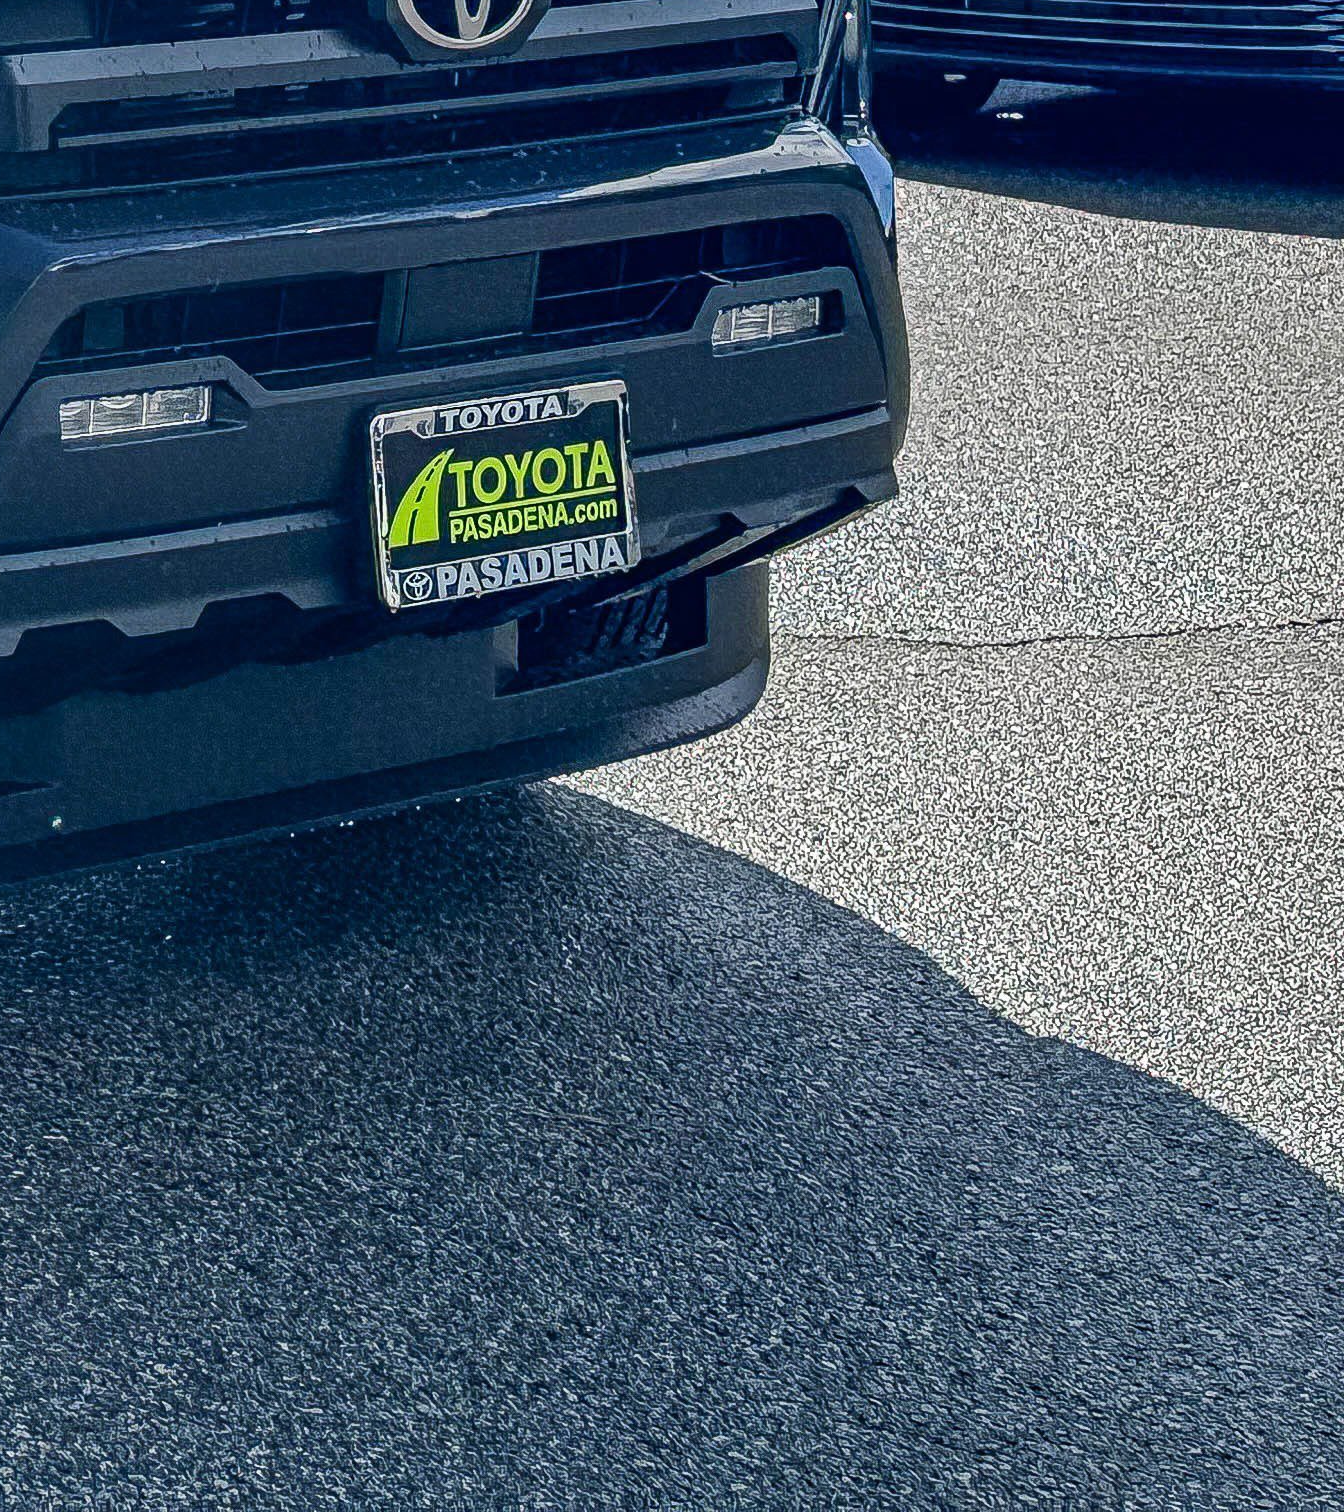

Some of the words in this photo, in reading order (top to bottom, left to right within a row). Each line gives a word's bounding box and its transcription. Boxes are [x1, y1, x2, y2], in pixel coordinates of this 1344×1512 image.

[440, 395, 562, 432] TOYOTA
[449, 440, 615, 508] TOYOTA
[450, 498, 617, 544] PASADENA.com
[437, 538, 625, 598] PASADENA
